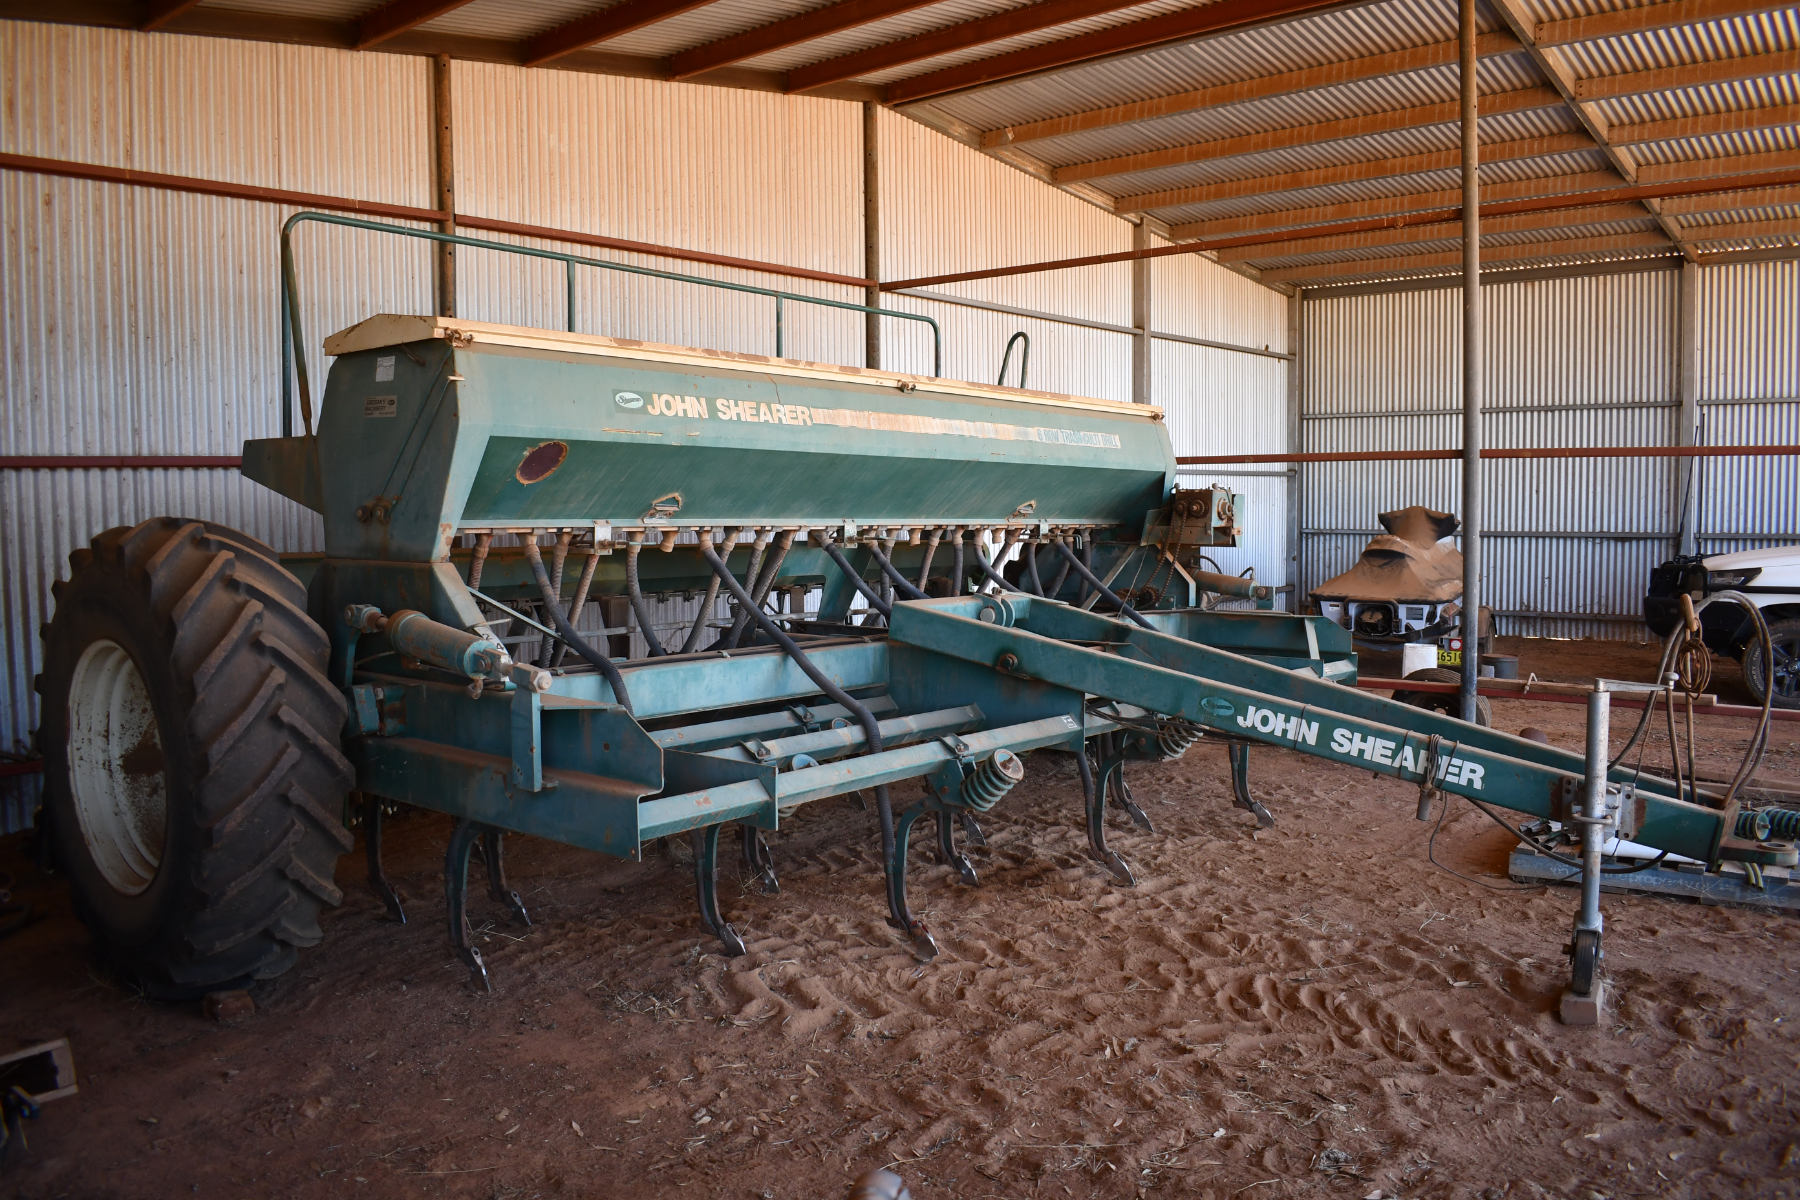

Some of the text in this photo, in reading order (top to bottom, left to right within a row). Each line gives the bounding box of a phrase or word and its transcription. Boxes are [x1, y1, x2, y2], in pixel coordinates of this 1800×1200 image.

[647, 393, 812, 426] JOHN SHEARER
[1236, 705, 1319, 746] JOHN
